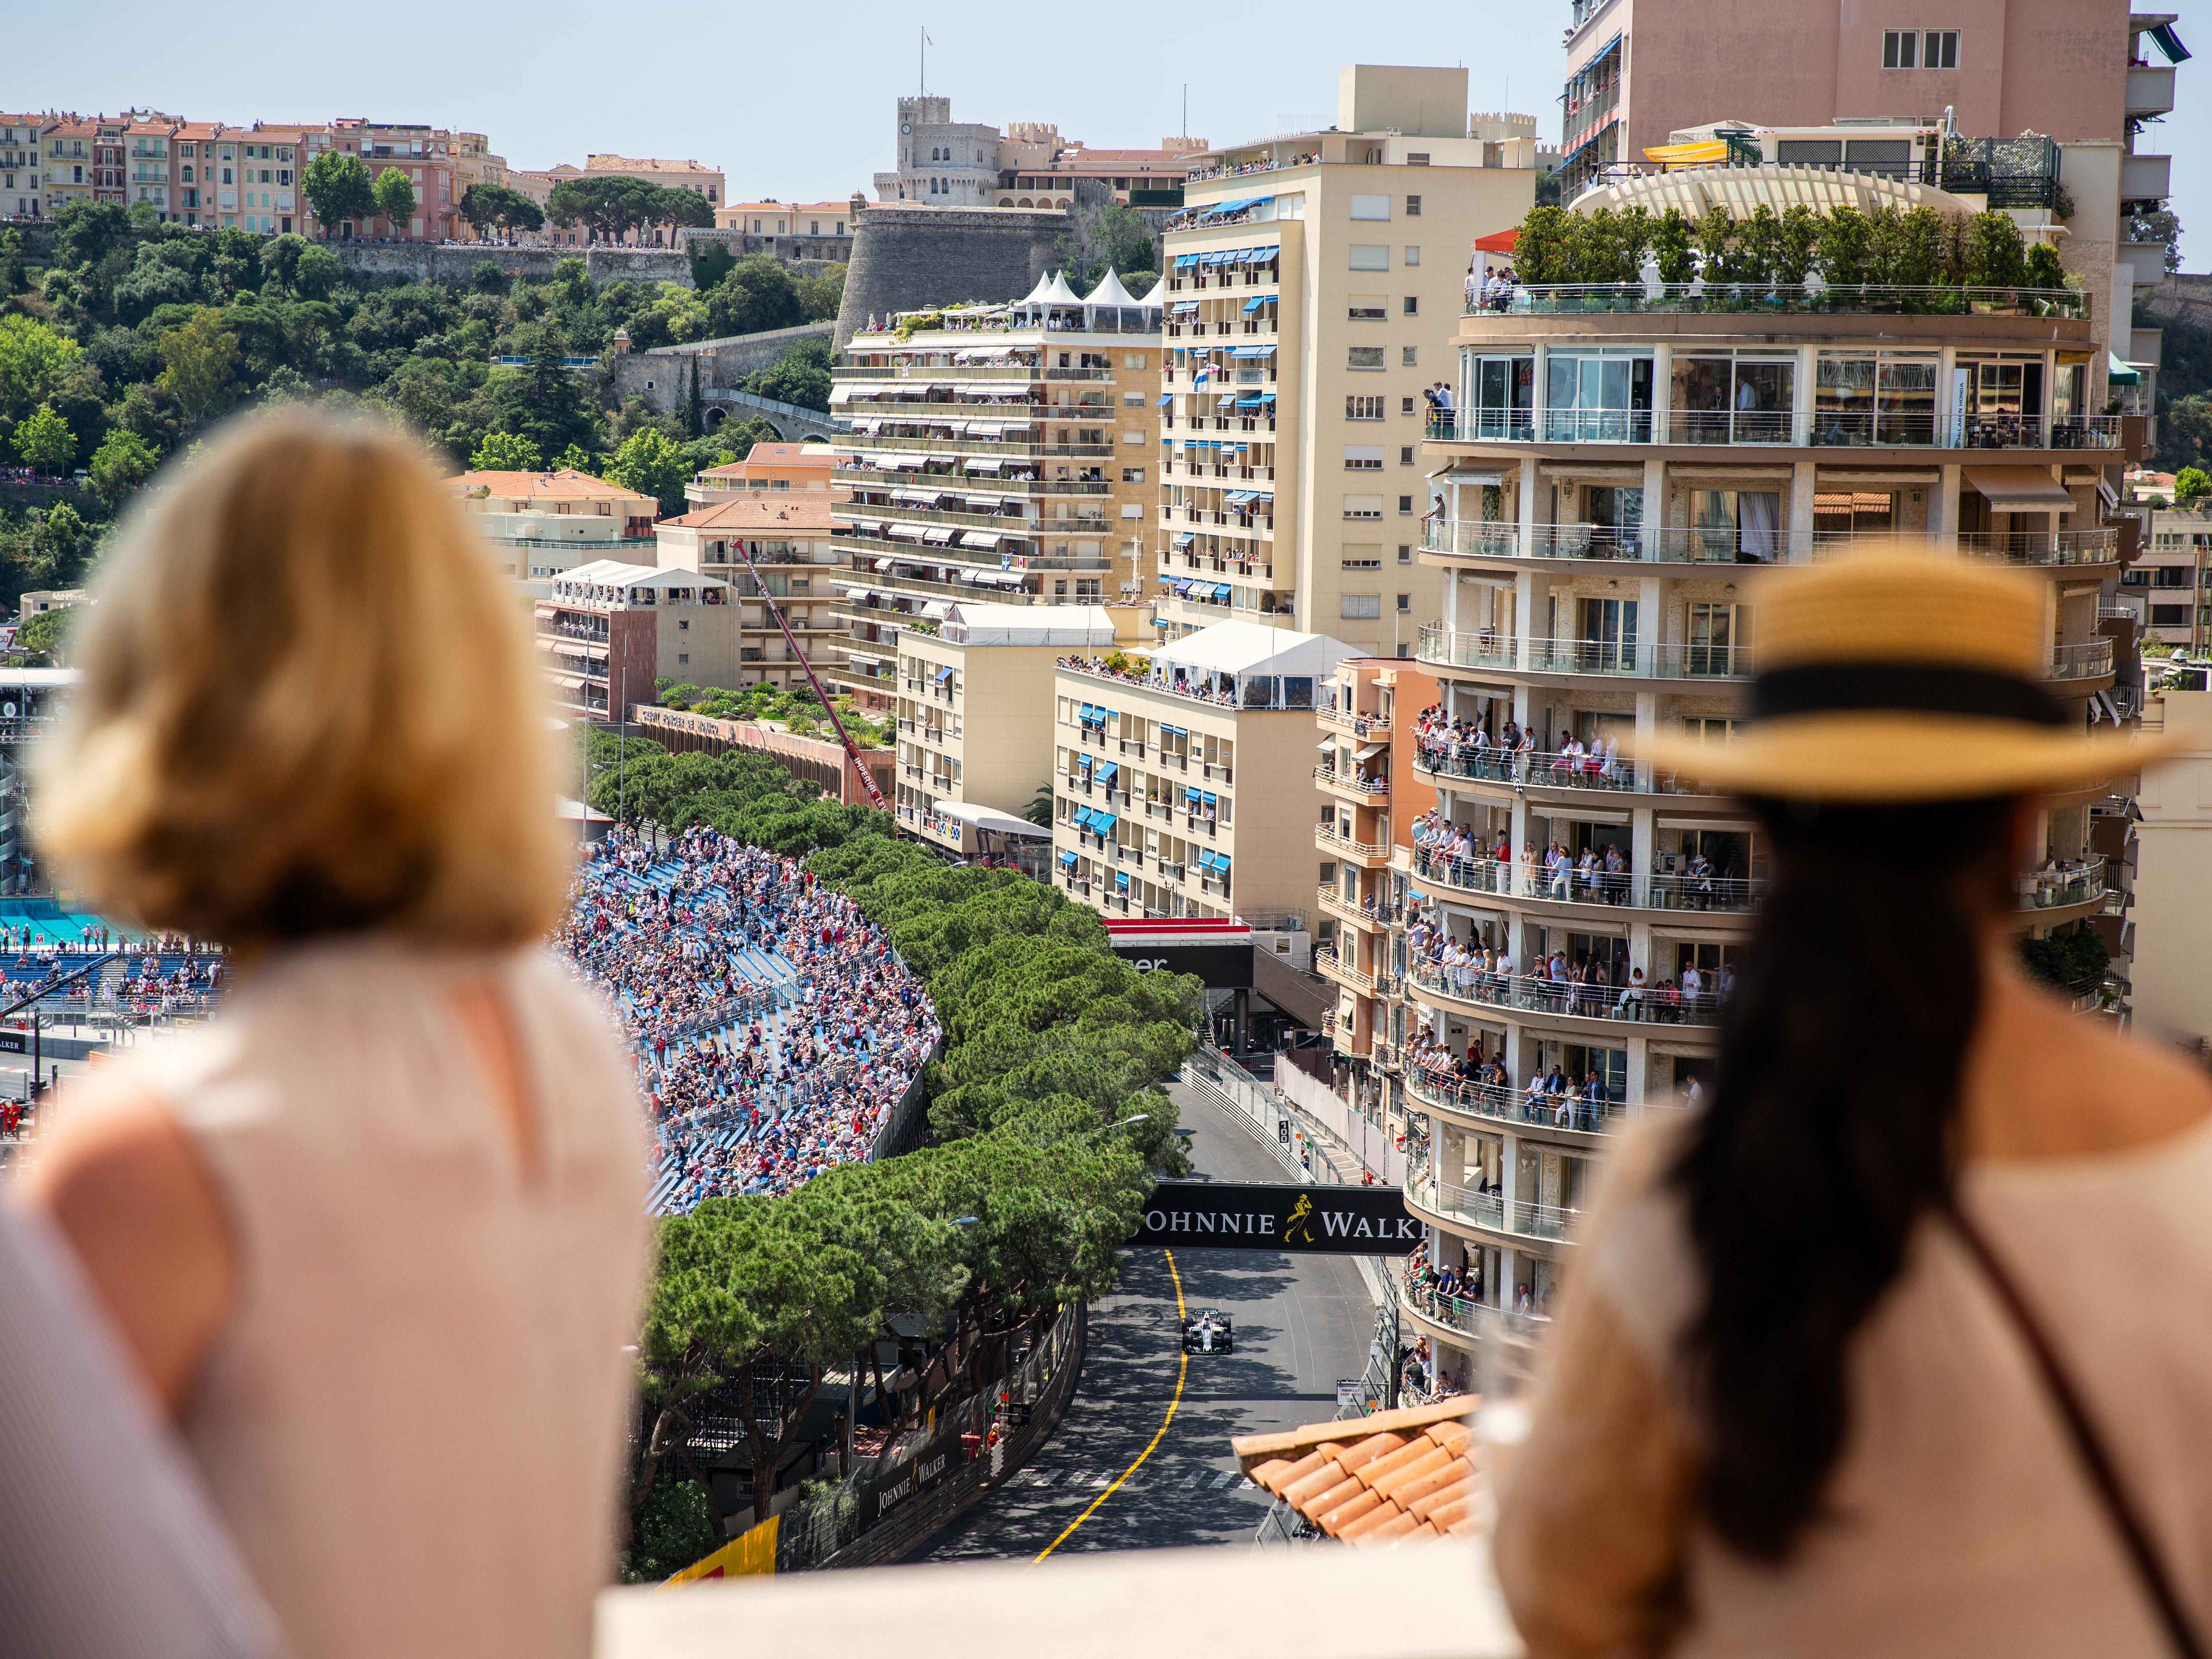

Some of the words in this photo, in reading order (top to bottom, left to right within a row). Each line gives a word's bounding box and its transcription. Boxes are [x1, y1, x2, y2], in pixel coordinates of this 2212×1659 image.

[746, 559, 763, 588] IMPERIAL
[761, 588, 775, 611] LEVAGE
[663, 714, 684, 726] FONCIER
[688, 718, 694, 728] DE
[697, 721, 718, 733] MONACO
[854, 757, 877, 795] IMPERIAL
[1128, 959, 1168, 971] er
[0, 1041, 19, 1049] LKER
[1128, 1211, 1274, 1238] OHNNIE
[878, 1478, 910, 1517] JOHNNIE
[918, 1454, 945, 1484] WALKER
